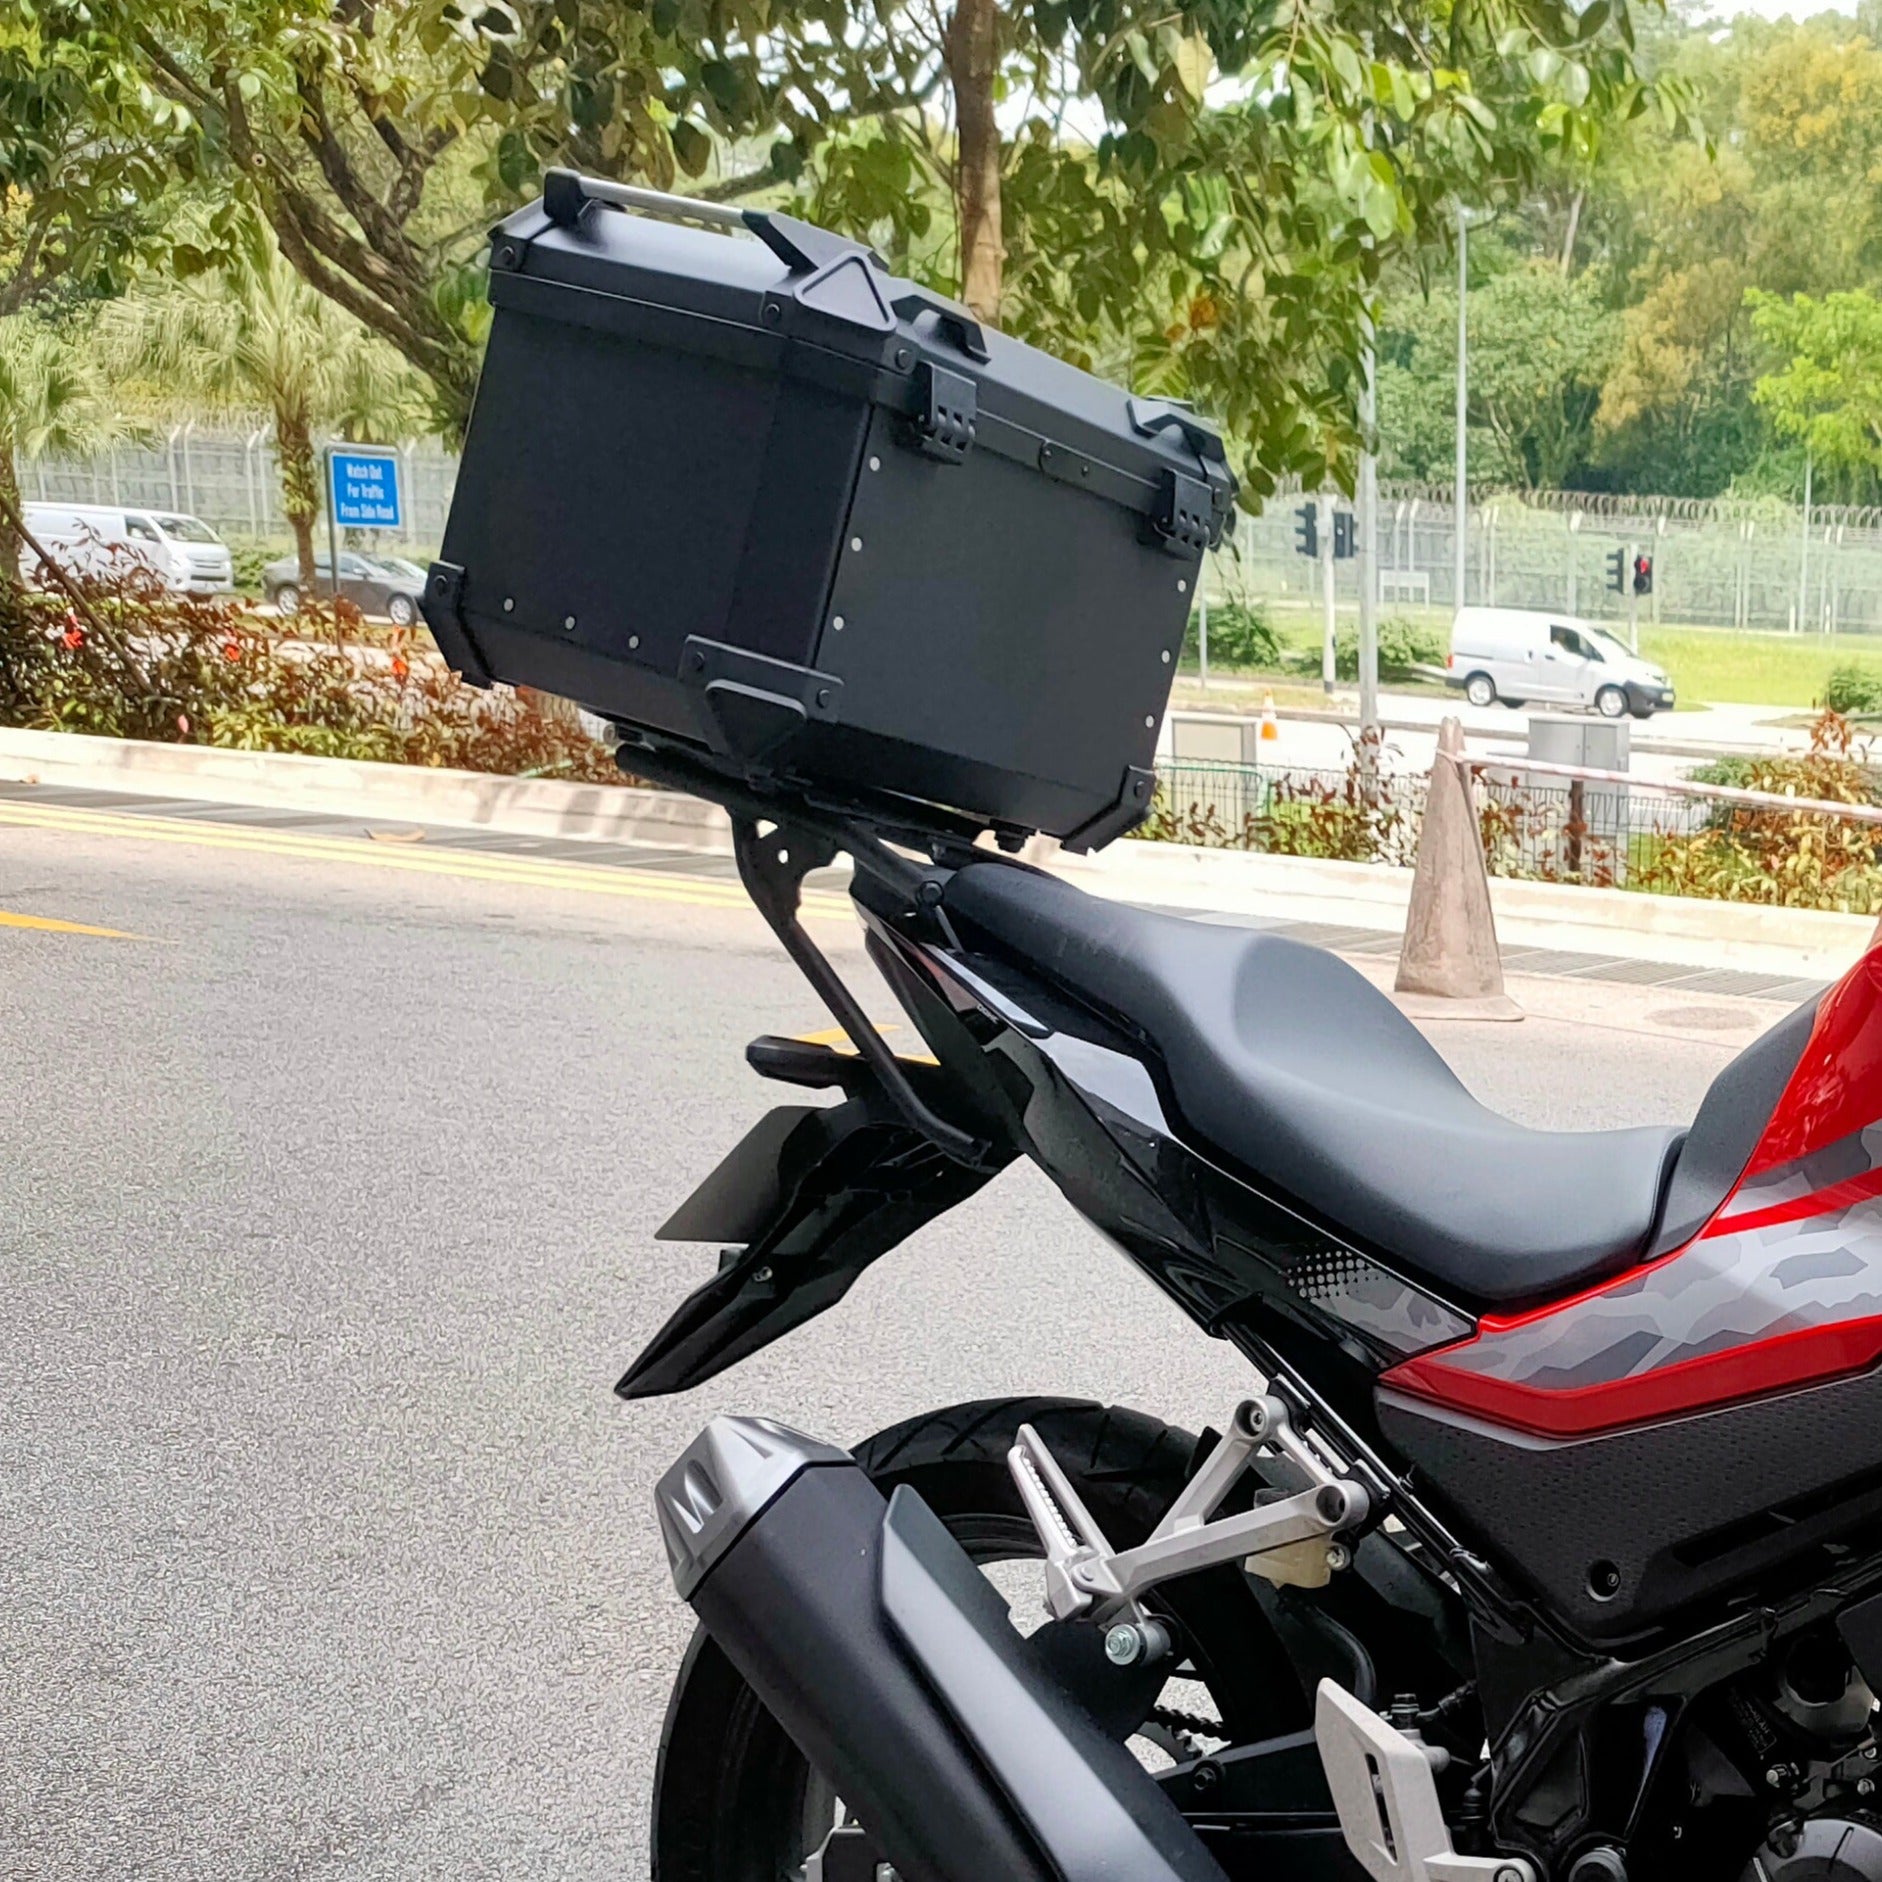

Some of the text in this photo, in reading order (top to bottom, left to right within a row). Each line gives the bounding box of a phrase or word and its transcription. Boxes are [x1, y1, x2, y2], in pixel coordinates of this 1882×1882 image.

[346, 463, 383, 480] Watch Out
[347, 482, 384, 500] For Traffic
[340, 502, 360, 518] From
[361, 503, 376, 519] Side
